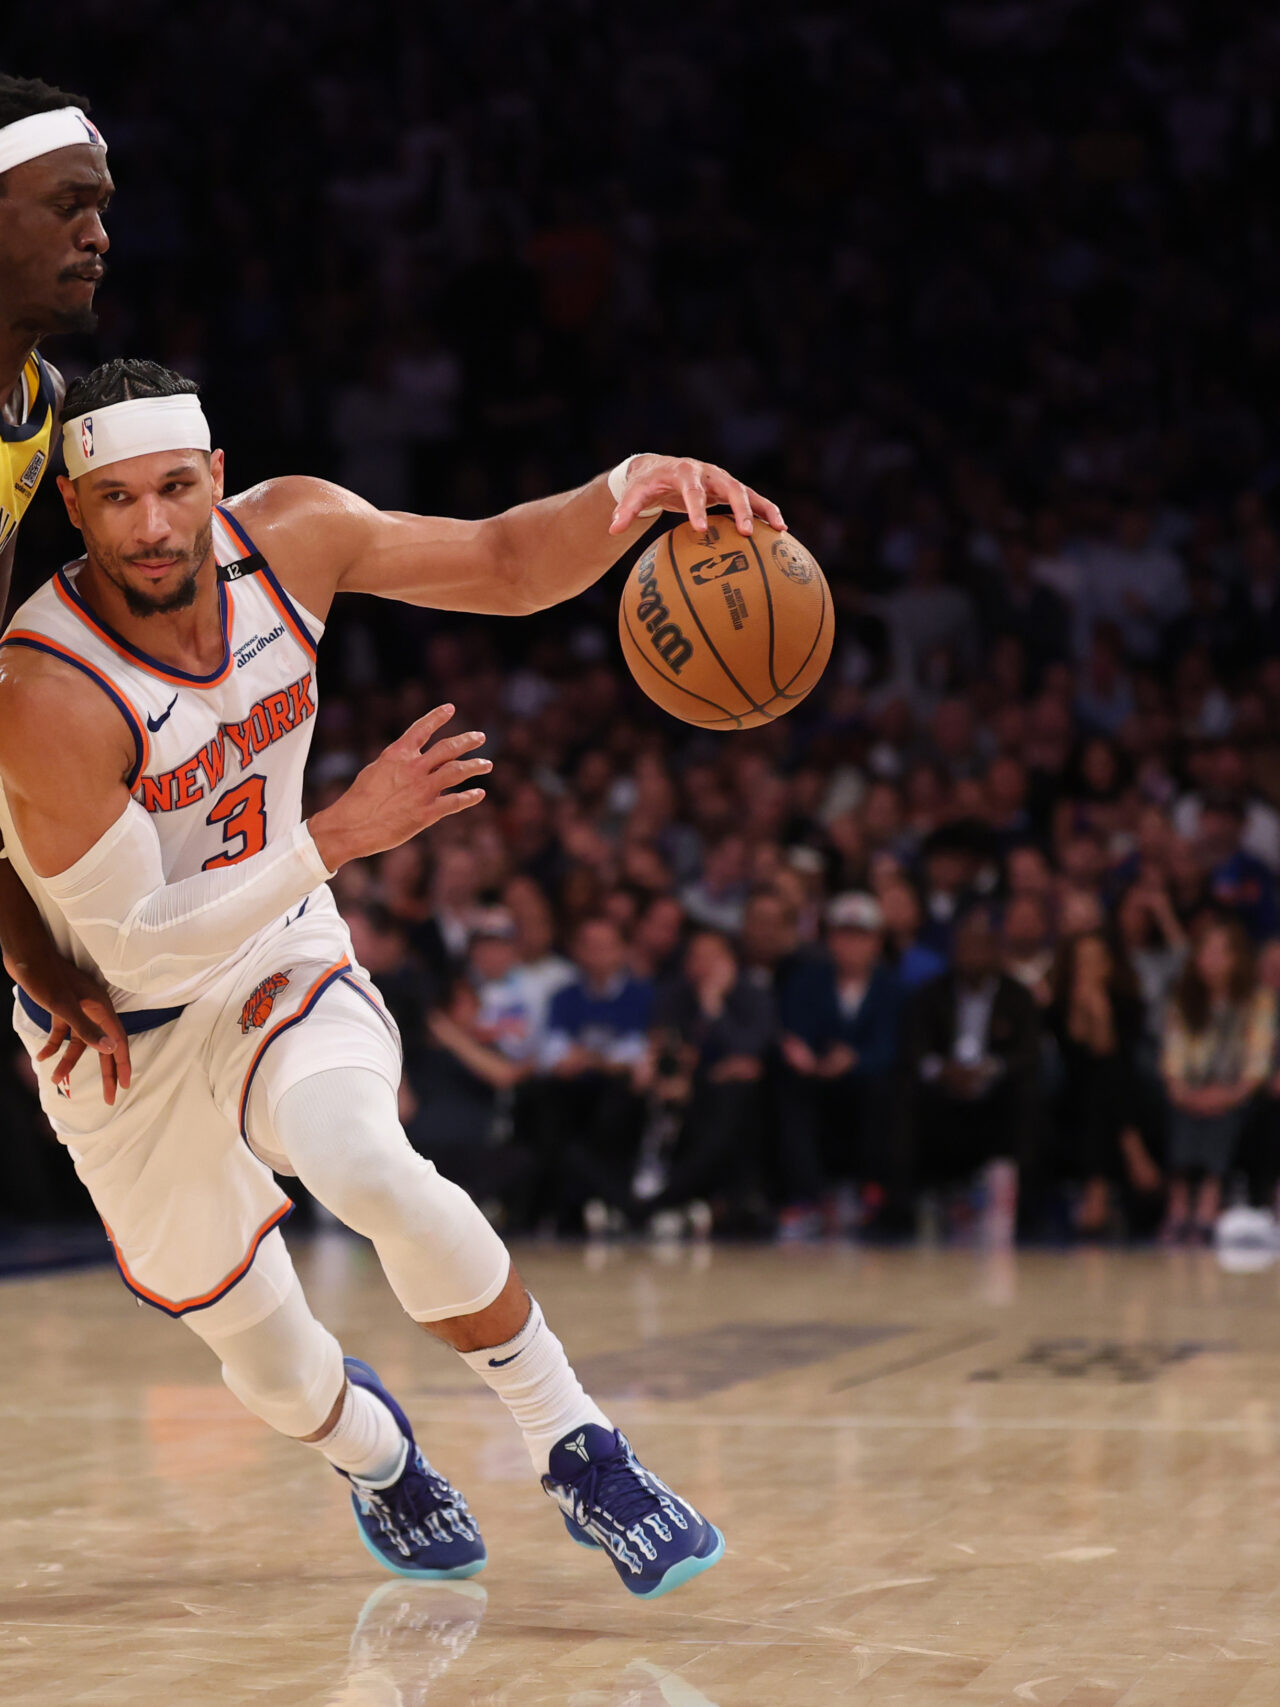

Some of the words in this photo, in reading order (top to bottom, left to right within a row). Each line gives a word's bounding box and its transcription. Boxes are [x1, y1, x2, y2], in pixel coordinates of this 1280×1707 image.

[227, 563, 242, 580] 12
[637, 543, 694, 676] Wilson
[237, 648, 257, 668] abu
[256, 621, 285, 652] dhabi
[140, 726, 225, 814] NEW
[223, 672, 316, 772] YORK
[201, 773, 267, 872] 3
